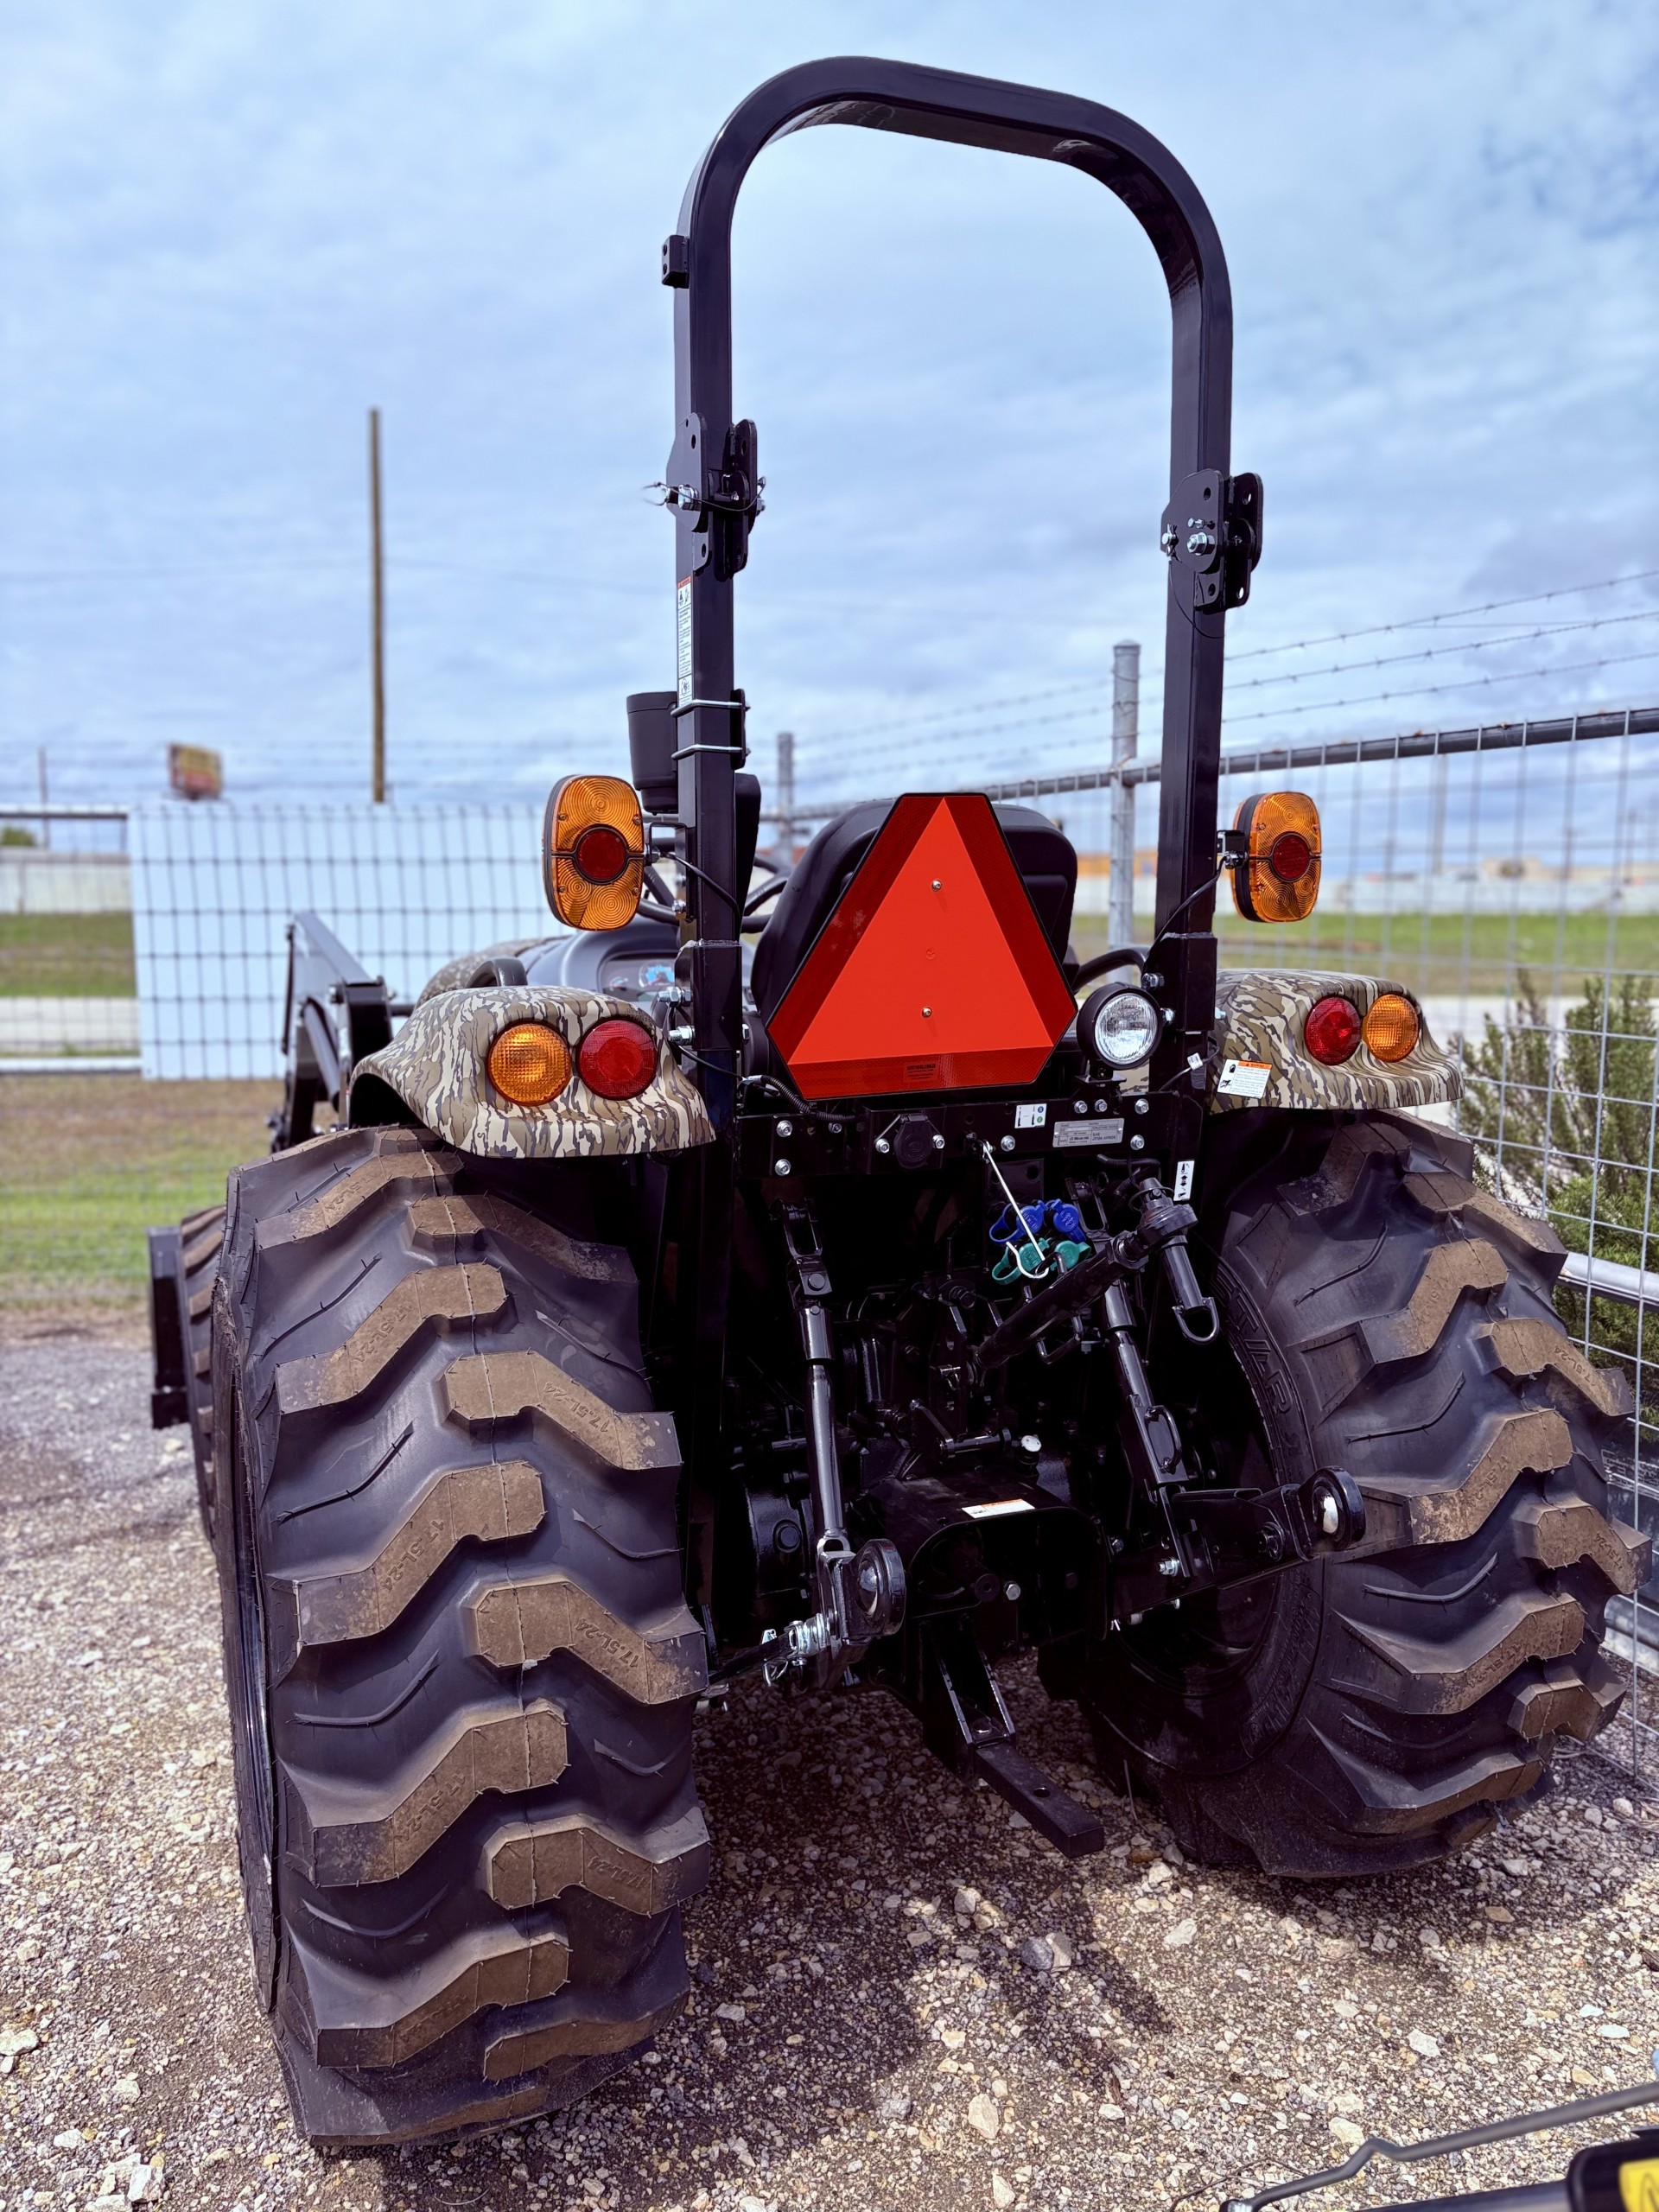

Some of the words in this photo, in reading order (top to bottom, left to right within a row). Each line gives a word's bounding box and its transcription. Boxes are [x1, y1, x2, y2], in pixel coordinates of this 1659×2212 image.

[543, 1382, 610, 1433] 17.5L-24
[381, 1520, 444, 1591] 17.5L-24
[575, 1618, 639, 1668] 17.5L-24
